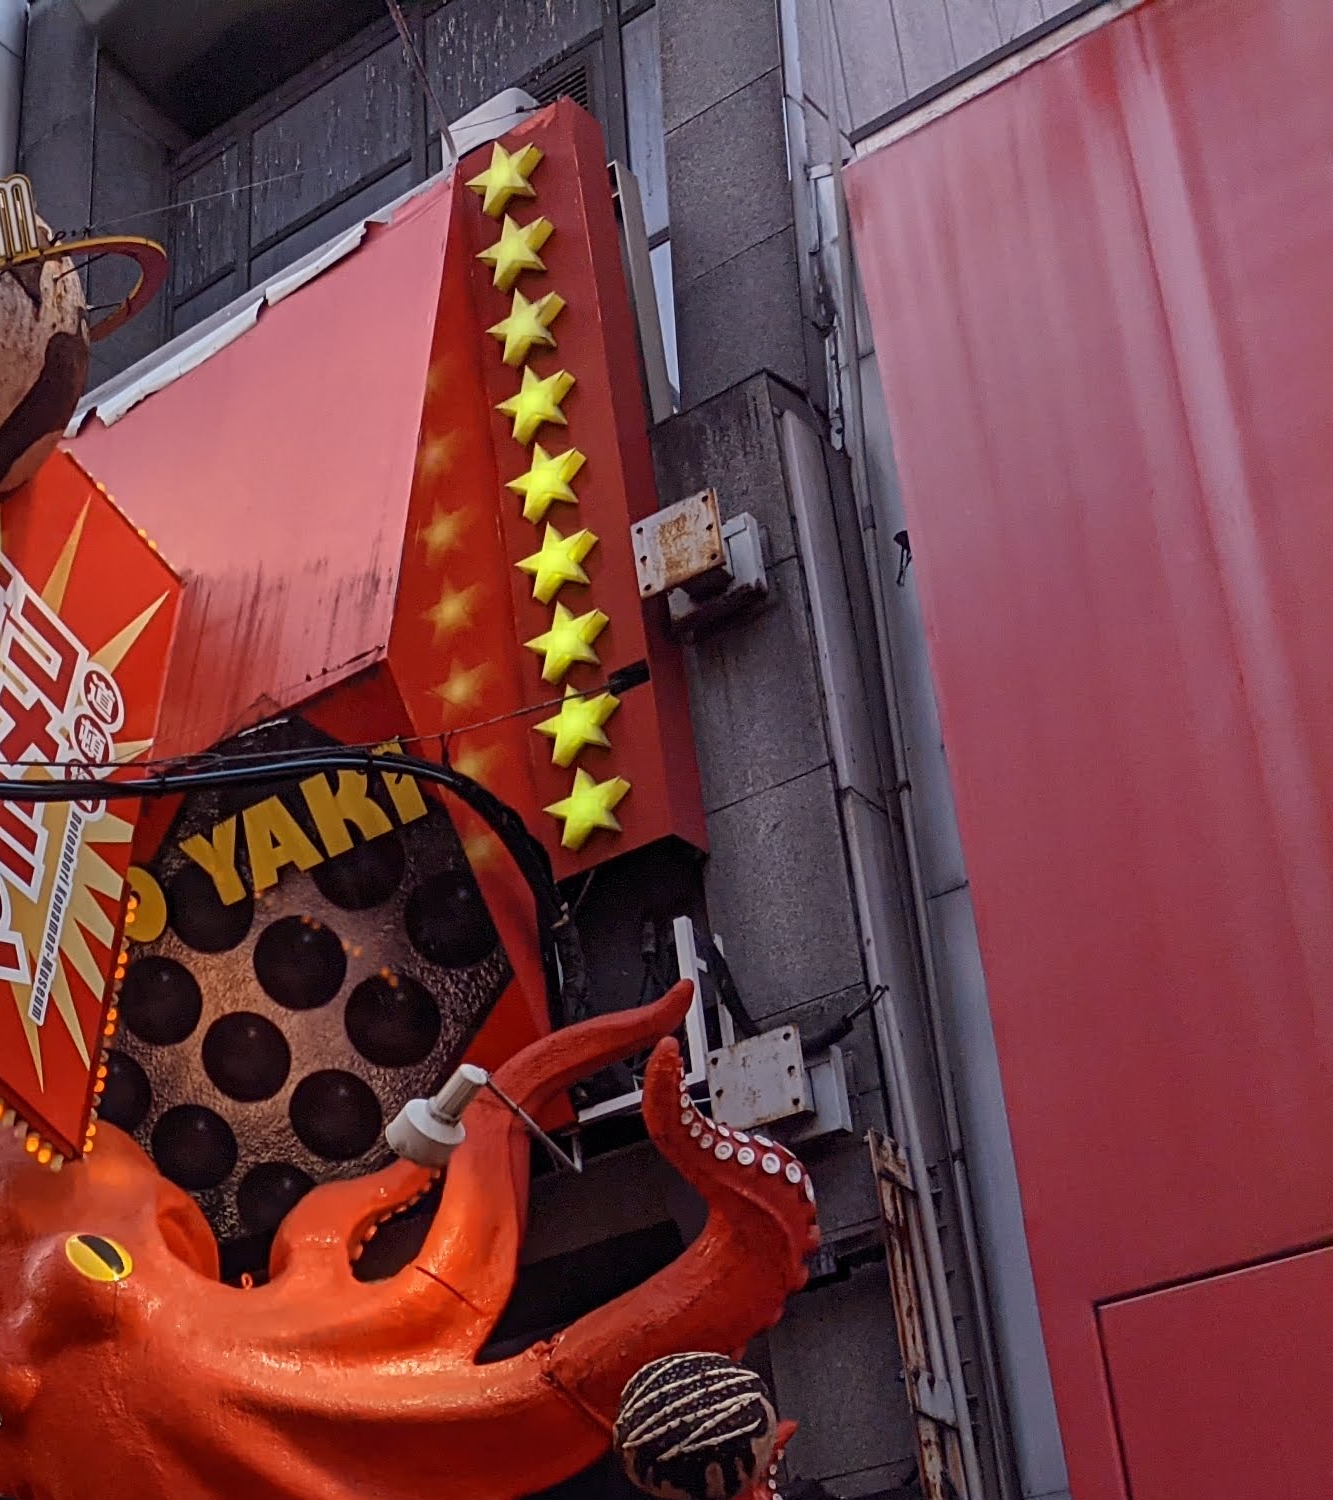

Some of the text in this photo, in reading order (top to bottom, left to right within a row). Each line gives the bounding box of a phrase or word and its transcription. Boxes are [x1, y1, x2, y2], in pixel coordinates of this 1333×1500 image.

[32, 811, 82, 1021] Dotonbori Konamon-Museum
[179, 736, 430, 907] YAKI
